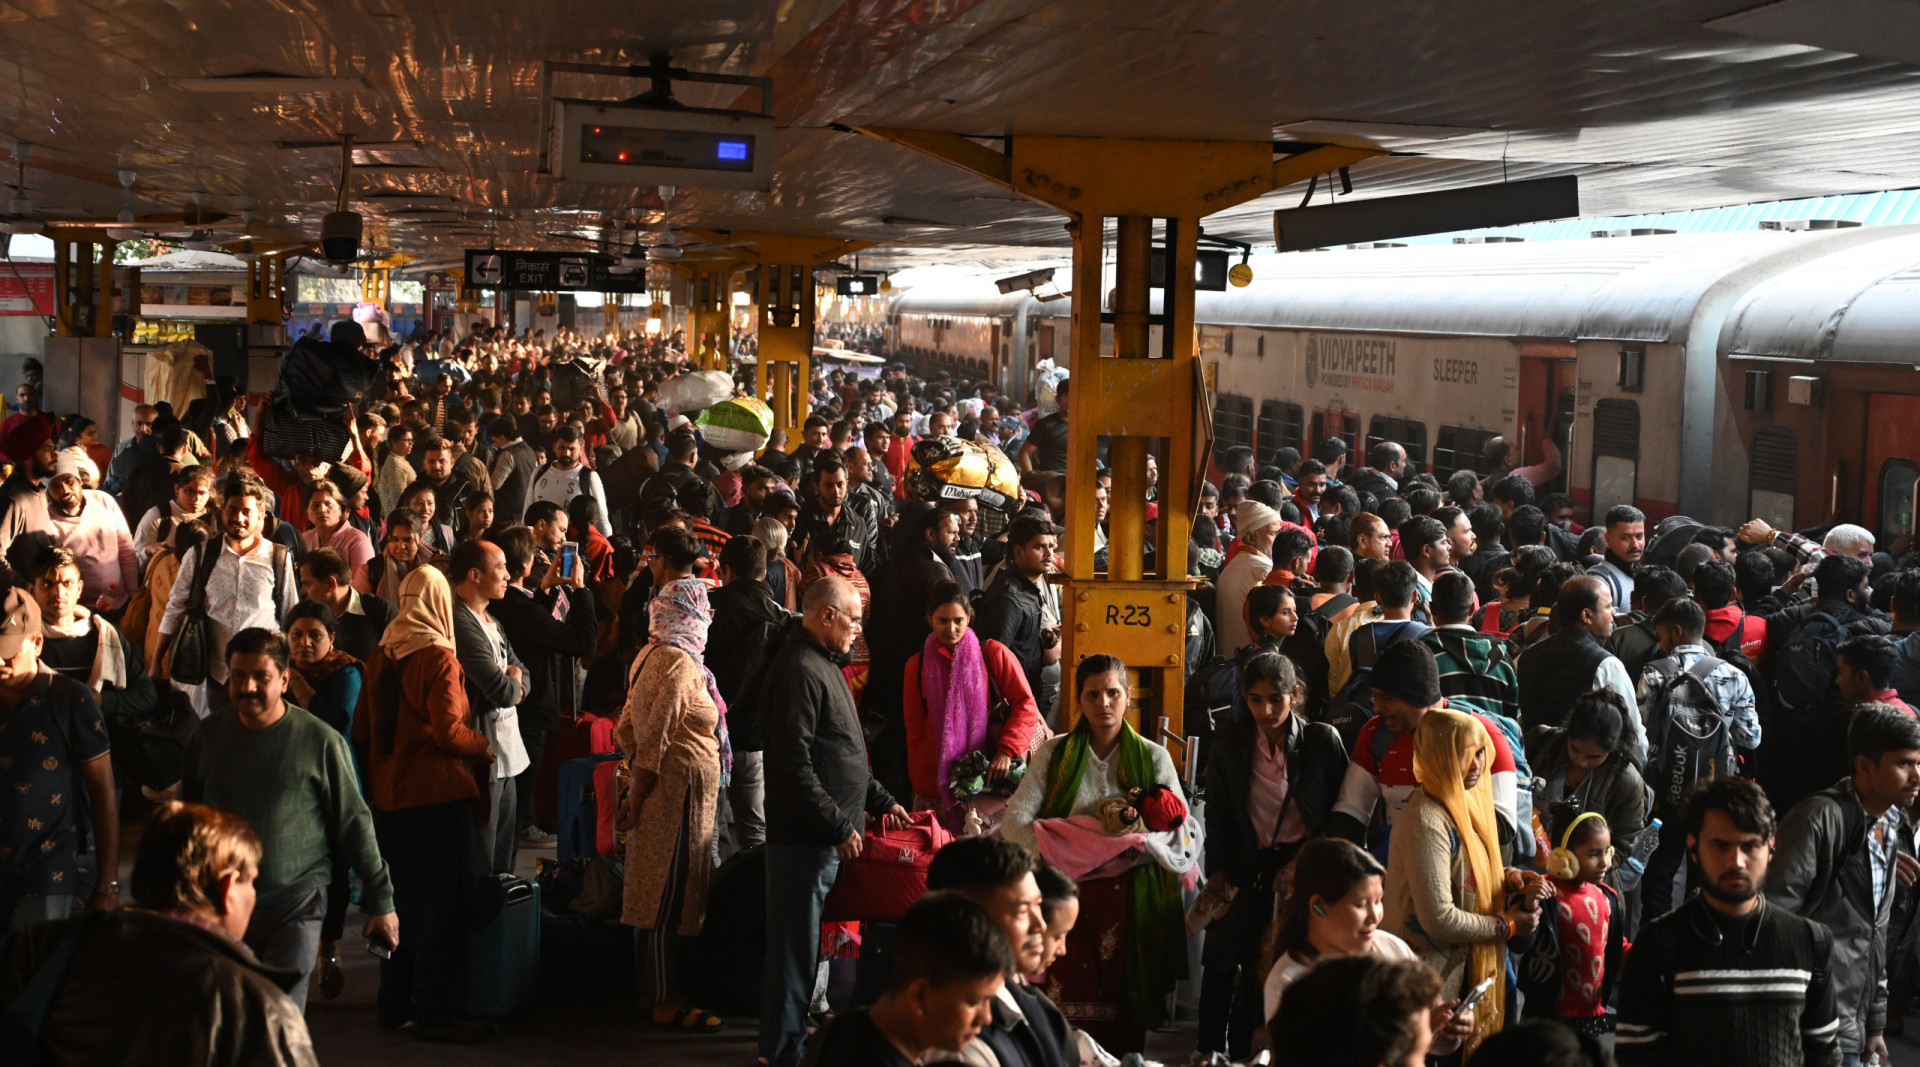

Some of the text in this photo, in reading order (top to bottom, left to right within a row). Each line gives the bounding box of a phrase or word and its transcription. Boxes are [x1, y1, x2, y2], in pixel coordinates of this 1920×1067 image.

[514, 258, 550, 272] निकास
[519, 273, 545, 284] EXIT
[1320, 337, 1396, 376] VIDYAPEETH
[1433, 357, 1478, 385] SLEEPER
[1321, 373, 1395, 394] POWERED BY PHYSICS WALLAH
[1106, 604, 1152, 627] R-23
[1332, 714, 1352, 725] safari
[1667, 744, 1688, 805] Reebok
